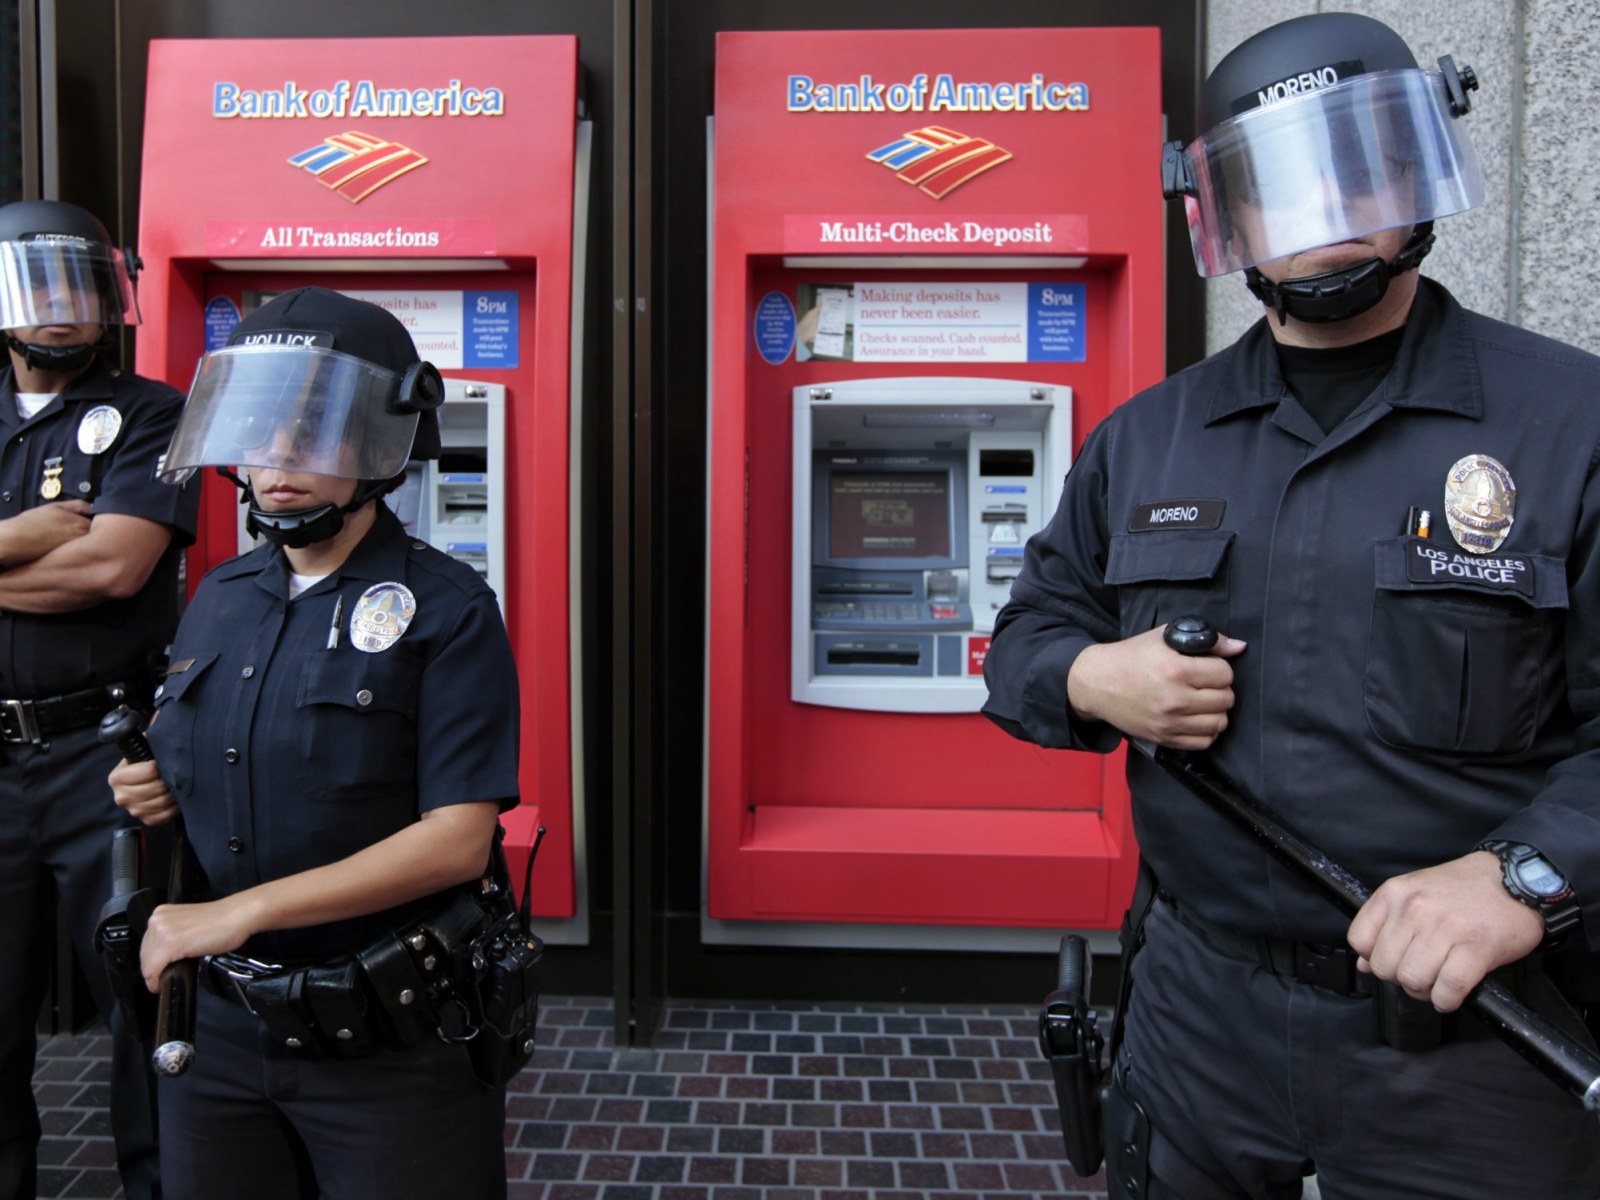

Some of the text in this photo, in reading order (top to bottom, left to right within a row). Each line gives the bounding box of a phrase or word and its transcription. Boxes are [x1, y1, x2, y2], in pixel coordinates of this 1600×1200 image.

[787, 73, 1090, 113] Bank of America
[1256, 66, 1338, 107] MORENO
[212, 79, 505, 119] Bank of America
[260, 227, 440, 248] All Transactions
[820, 222, 1053, 247] Multi-Check Deposit
[413, 297, 438, 310] has
[476, 296, 508, 314] 8PM
[860, 288, 1001, 305] Making deposits has
[1041, 287, 1074, 306] 8PM
[860, 306, 981, 319] never been easier.
[244, 333, 317, 349] HOLLICK
[417, 340, 459, 351] counted.
[860, 332, 898, 344] Checks
[900, 332, 947, 344] scanned.
[949, 332, 976, 344] Cash
[860, 346, 987, 359] Assurance in your hand.
[1149, 506, 1199, 523] MORENO
[1416, 545, 1526, 572] LOS ANGELES
[1430, 559, 1517, 584] POLICE
